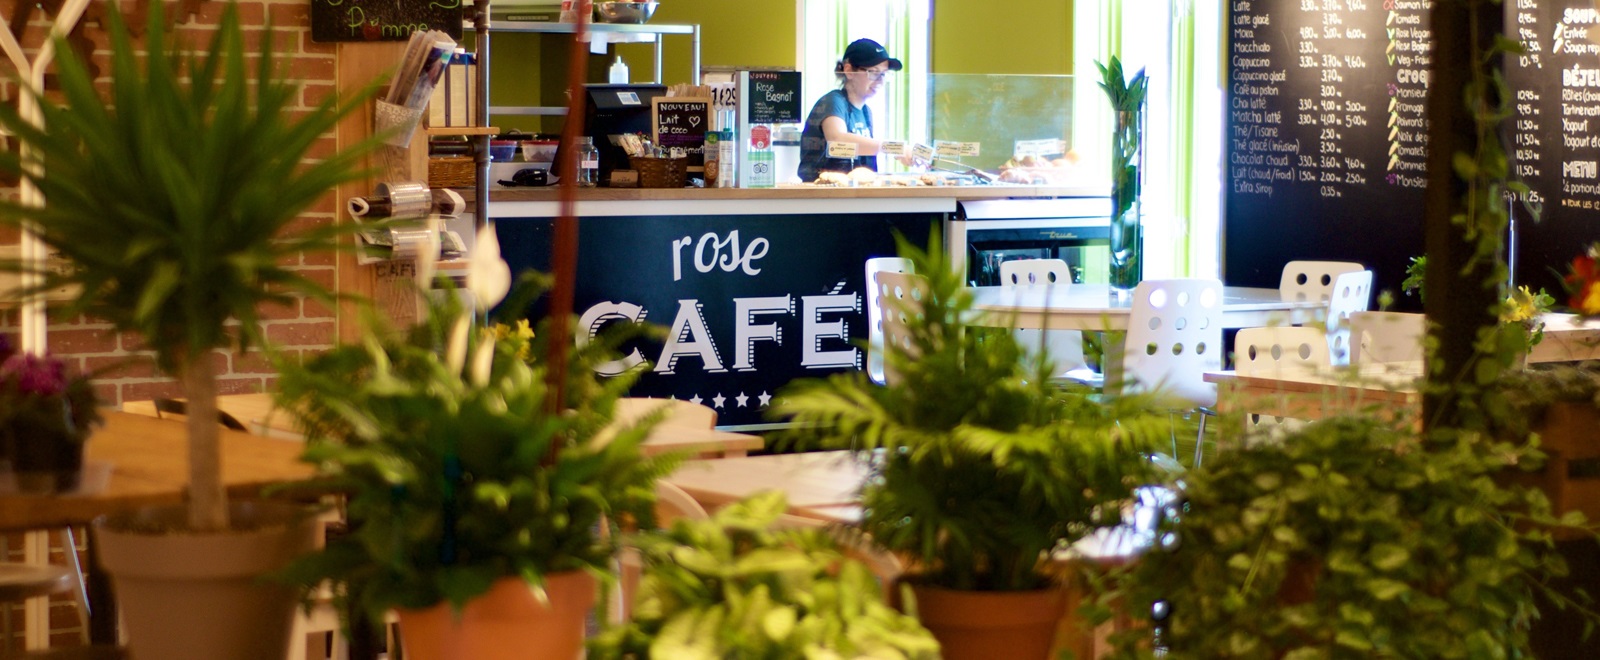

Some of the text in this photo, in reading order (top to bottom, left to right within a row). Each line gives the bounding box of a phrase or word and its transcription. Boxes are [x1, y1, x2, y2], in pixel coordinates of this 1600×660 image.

[1233, 0, 1250, 12] Latte
[1233, 15, 1251, 25] Latte
[1252, 14, 1270, 29] glacé
[1394, 13, 1420, 25] Tomates
[1395, 28, 1410, 39] Rose
[1234, 40, 1271, 53] Macchiato
[1395, 40, 1410, 51] Rose
[1563, 39, 1586, 56] Soupe
[1233, 55, 1270, 70] Cappuccino
[1233, 69, 1268, 83] Cappuccino
[1269, 69, 1287, 84] glacé
[756, 82, 774, 92] Rose
[1234, 82, 1250, 95] Café
[1250, 87, 1259, 95] au
[1259, 86, 1279, 97] piston
[1396, 89, 1427, 98] Monsieur
[765, 90, 794, 103] Bagnat
[1232, 96, 1248, 109] Chai
[660, 103, 705, 112] NOUVEAU!
[1395, 102, 1424, 117] Fromage
[1232, 111, 1262, 123] Matcha
[1396, 116, 1424, 128] Poivrons
[658, 125, 669, 134] de
[1562, 117, 1588, 135] Yogourt
[1397, 130, 1413, 142] Noix
[1414, 131, 1424, 143] de
[1563, 133, 1590, 151] Yogourt
[1232, 139, 1246, 150] Thé
[1248, 138, 1268, 154] glacé
[1231, 152, 1263, 165] Chocolat
[1232, 166, 1246, 179] Lait
[1234, 178, 1254, 194] Extra
[1254, 181, 1273, 198] Sirop
[672, 229, 770, 282] rose
[575, 279, 862, 378] CAFÉ
